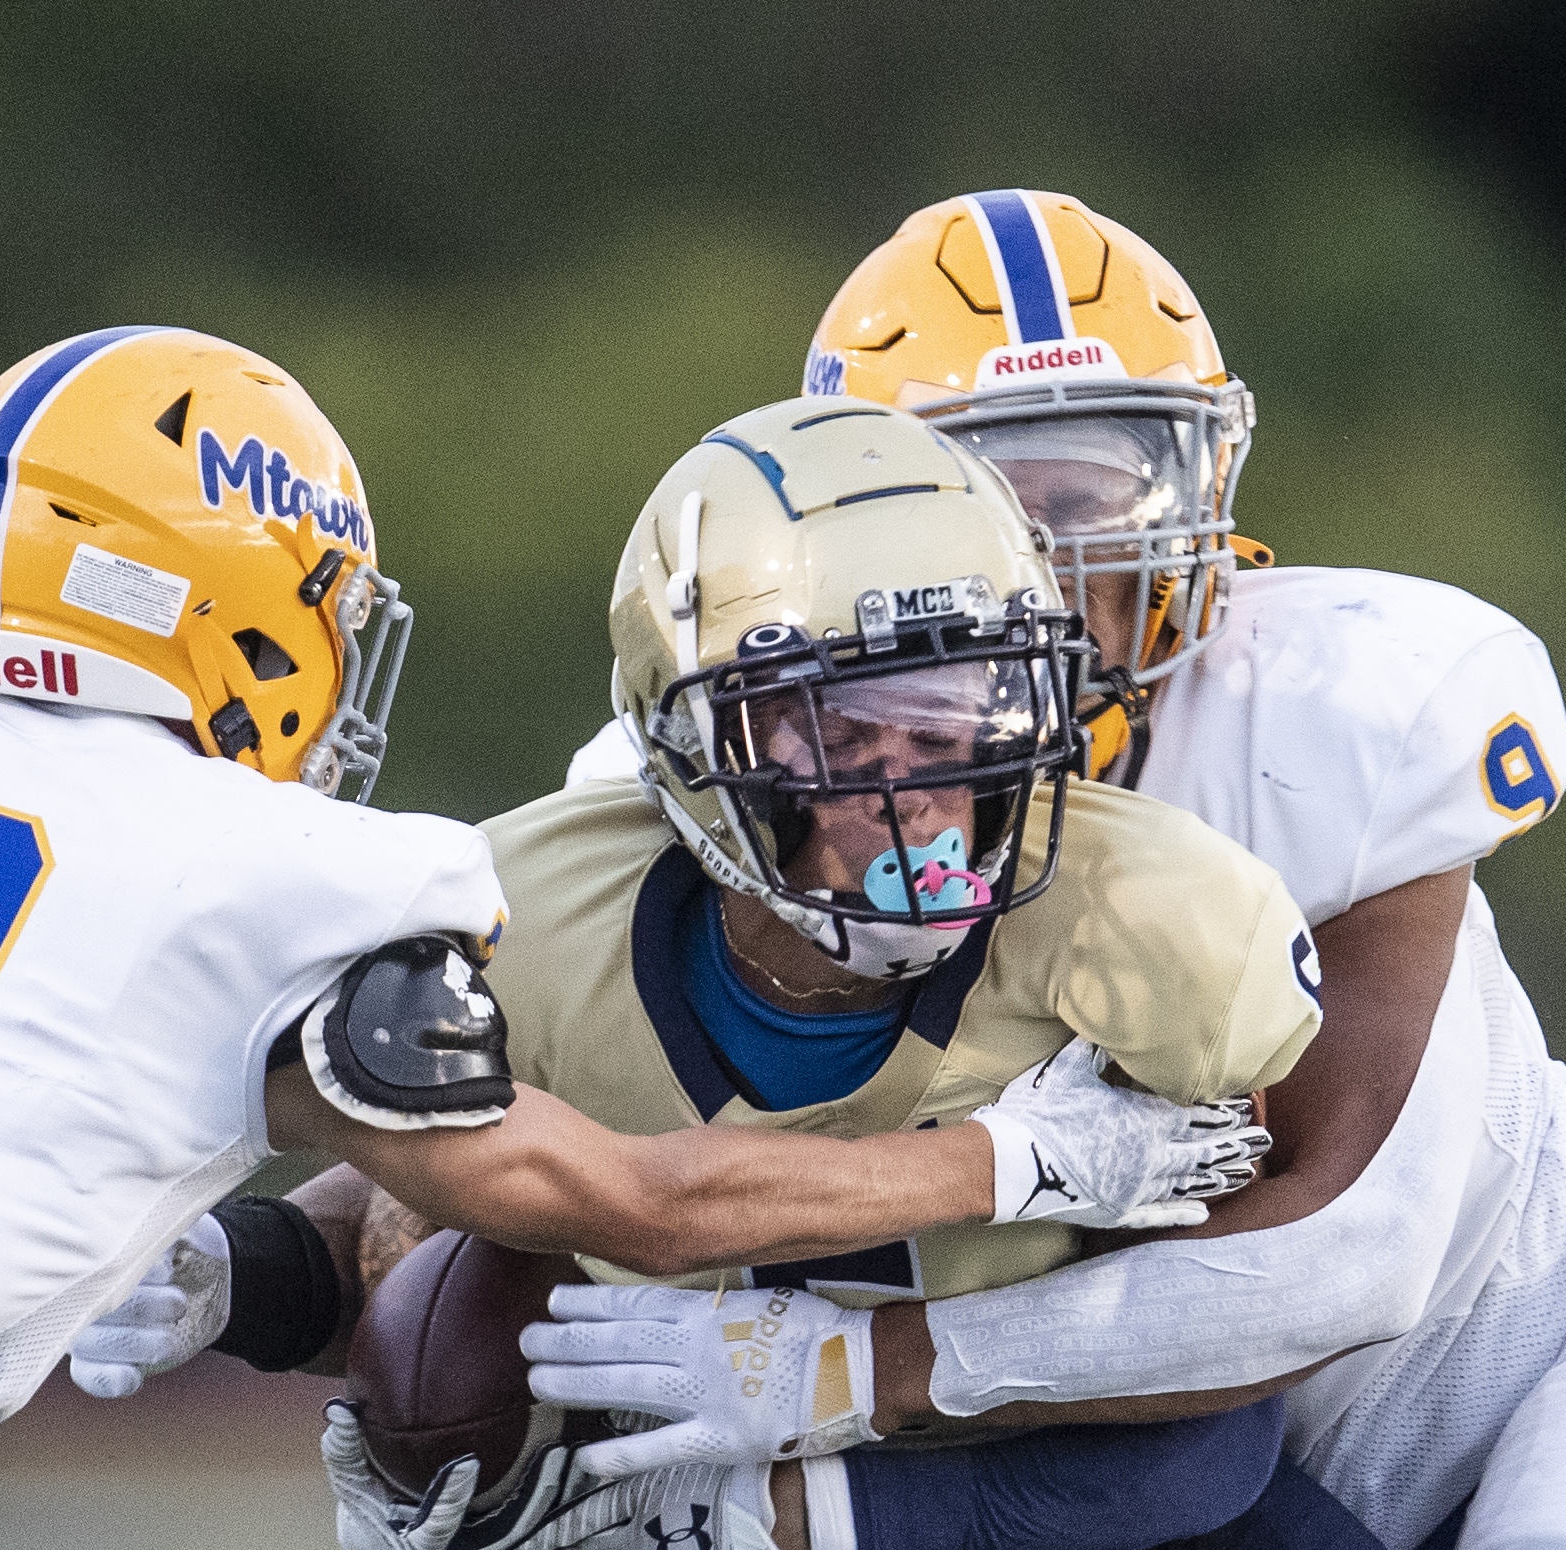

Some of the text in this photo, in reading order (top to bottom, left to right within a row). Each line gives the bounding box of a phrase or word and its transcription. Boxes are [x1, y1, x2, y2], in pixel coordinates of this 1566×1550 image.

[994, 345, 1103, 376] Riddell
[197, 428, 371, 554] Mtown
[114, 557, 153, 578] WARNING
[1479, 712, 1562, 857] 9
[740, 1286, 795, 1398] adidas
